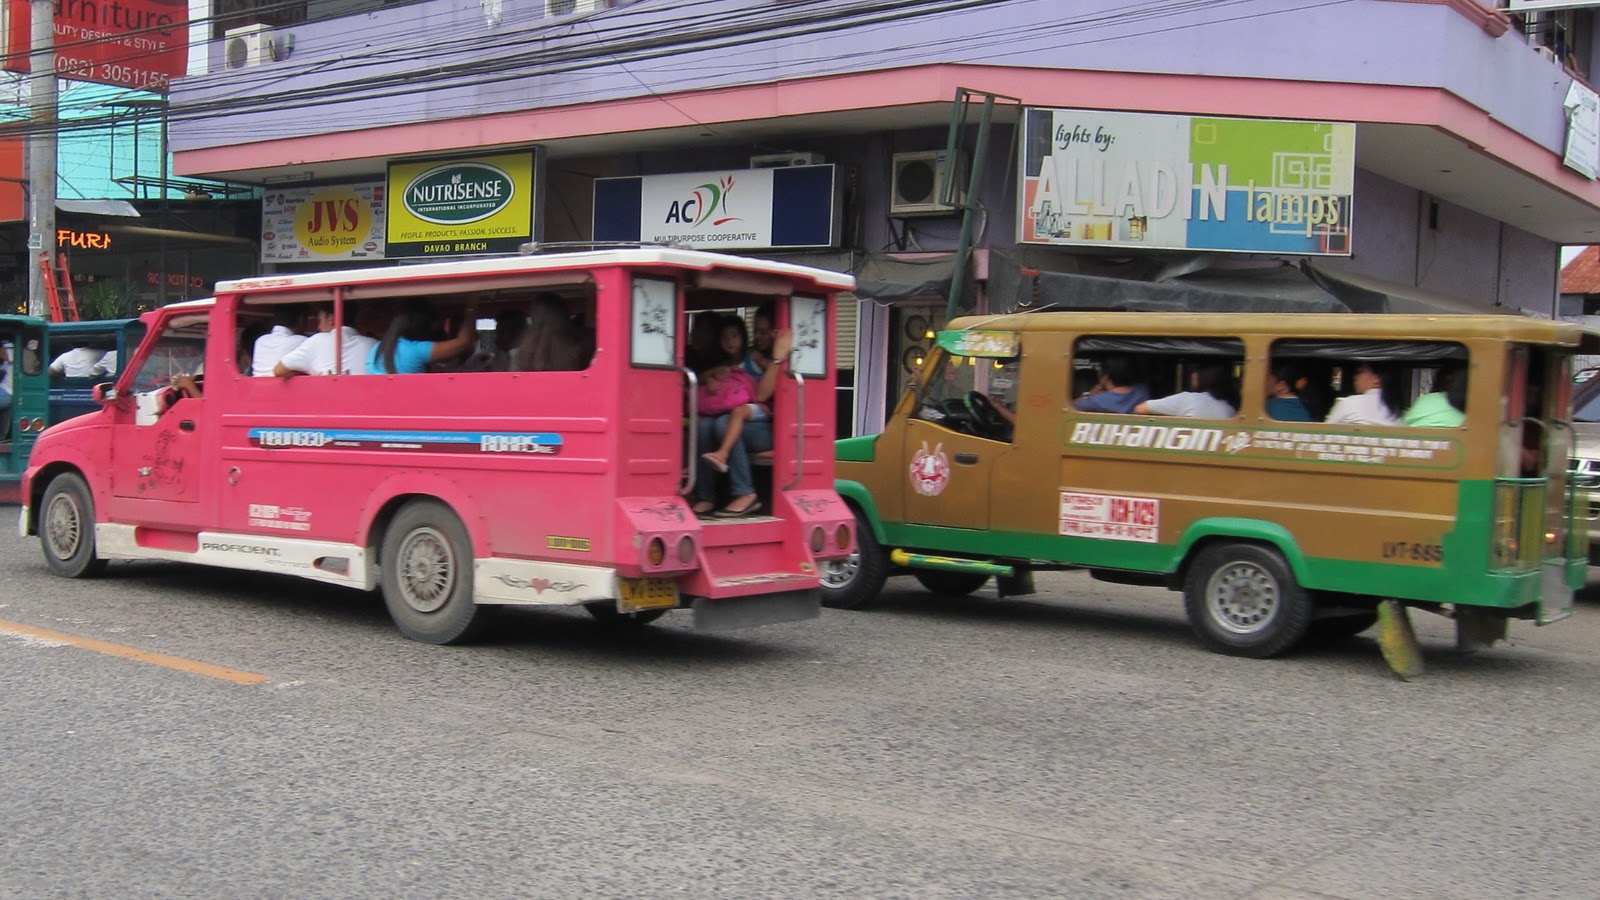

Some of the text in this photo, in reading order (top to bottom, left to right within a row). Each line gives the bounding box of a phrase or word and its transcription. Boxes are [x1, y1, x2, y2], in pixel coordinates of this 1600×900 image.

[53, 23, 78, 37] ALITY
[1055, 124, 1091, 150] lights
[413, 180, 502, 203] NUTRISENSE
[1032, 155, 1339, 238] ALLADIN lamps
[457, 202, 496, 210] INCORPORATED
[308, 198, 359, 233] JVS
[425, 230, 458, 238] PRODUCTS.
[460, 228, 487, 236] PASSION.
[707, 233, 757, 241] COOPERATIVE
[308, 236, 356, 248] Audio System
[424, 243, 487, 252] DAVAO BRANCH
